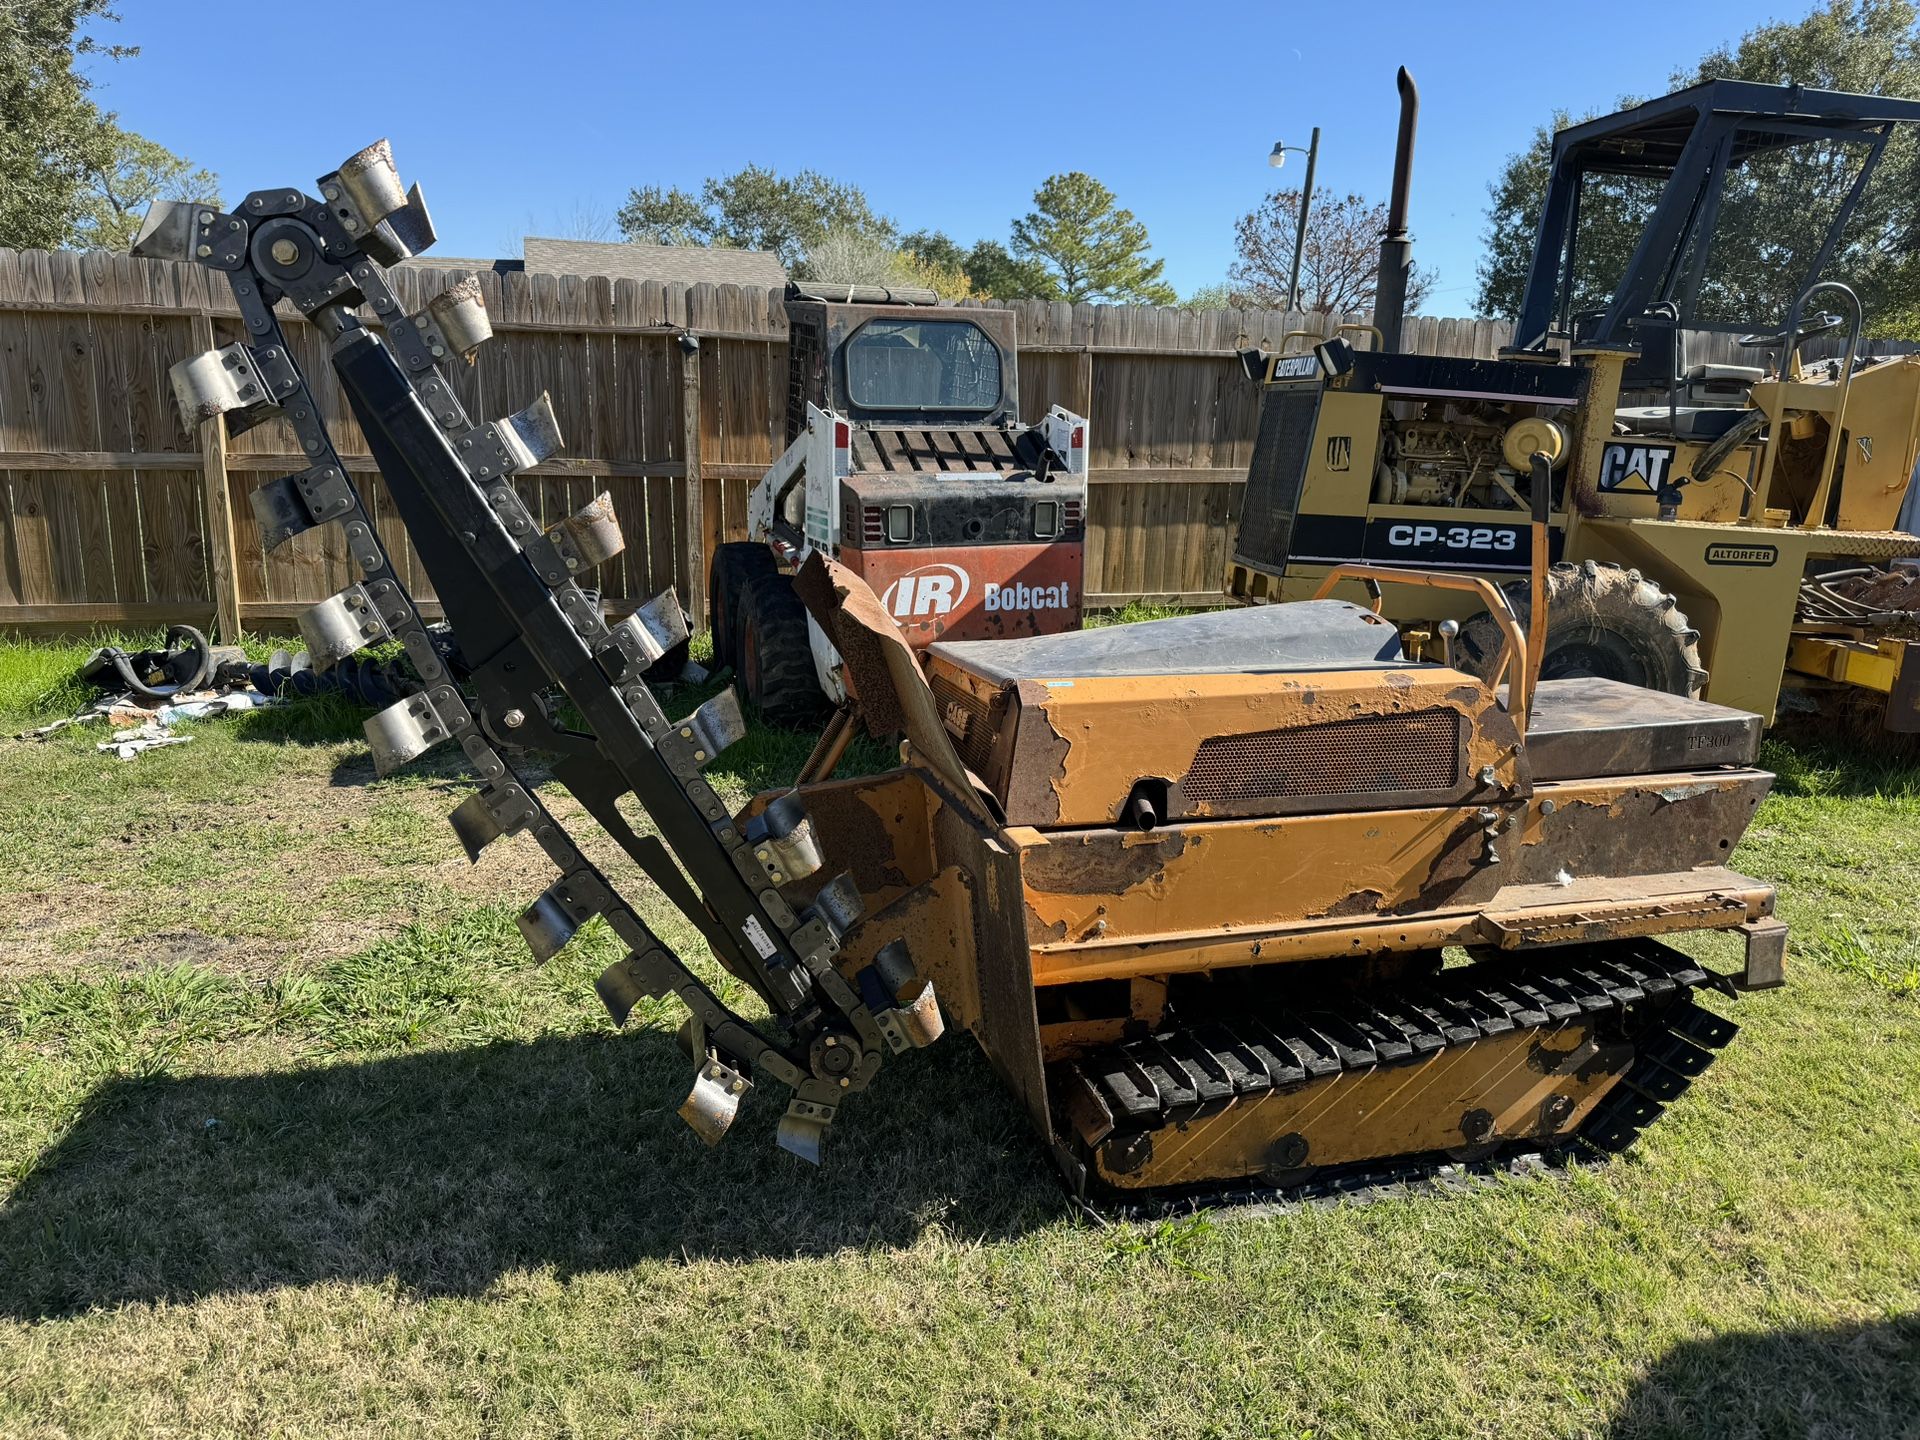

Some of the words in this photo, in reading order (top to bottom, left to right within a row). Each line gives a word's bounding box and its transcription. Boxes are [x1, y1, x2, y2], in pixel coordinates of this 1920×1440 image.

[1275, 356, 1316, 378] CATERPILLAR
[1600, 445, 1670, 492] CAT
[1388, 525, 1517, 551] CP-323
[1712, 549, 1771, 560] ALTORFER
[894, 575, 955, 617] IR
[984, 581, 1070, 612] Bobcat
[946, 701, 971, 731] CASE
[1688, 733, 1731, 751] TF300
